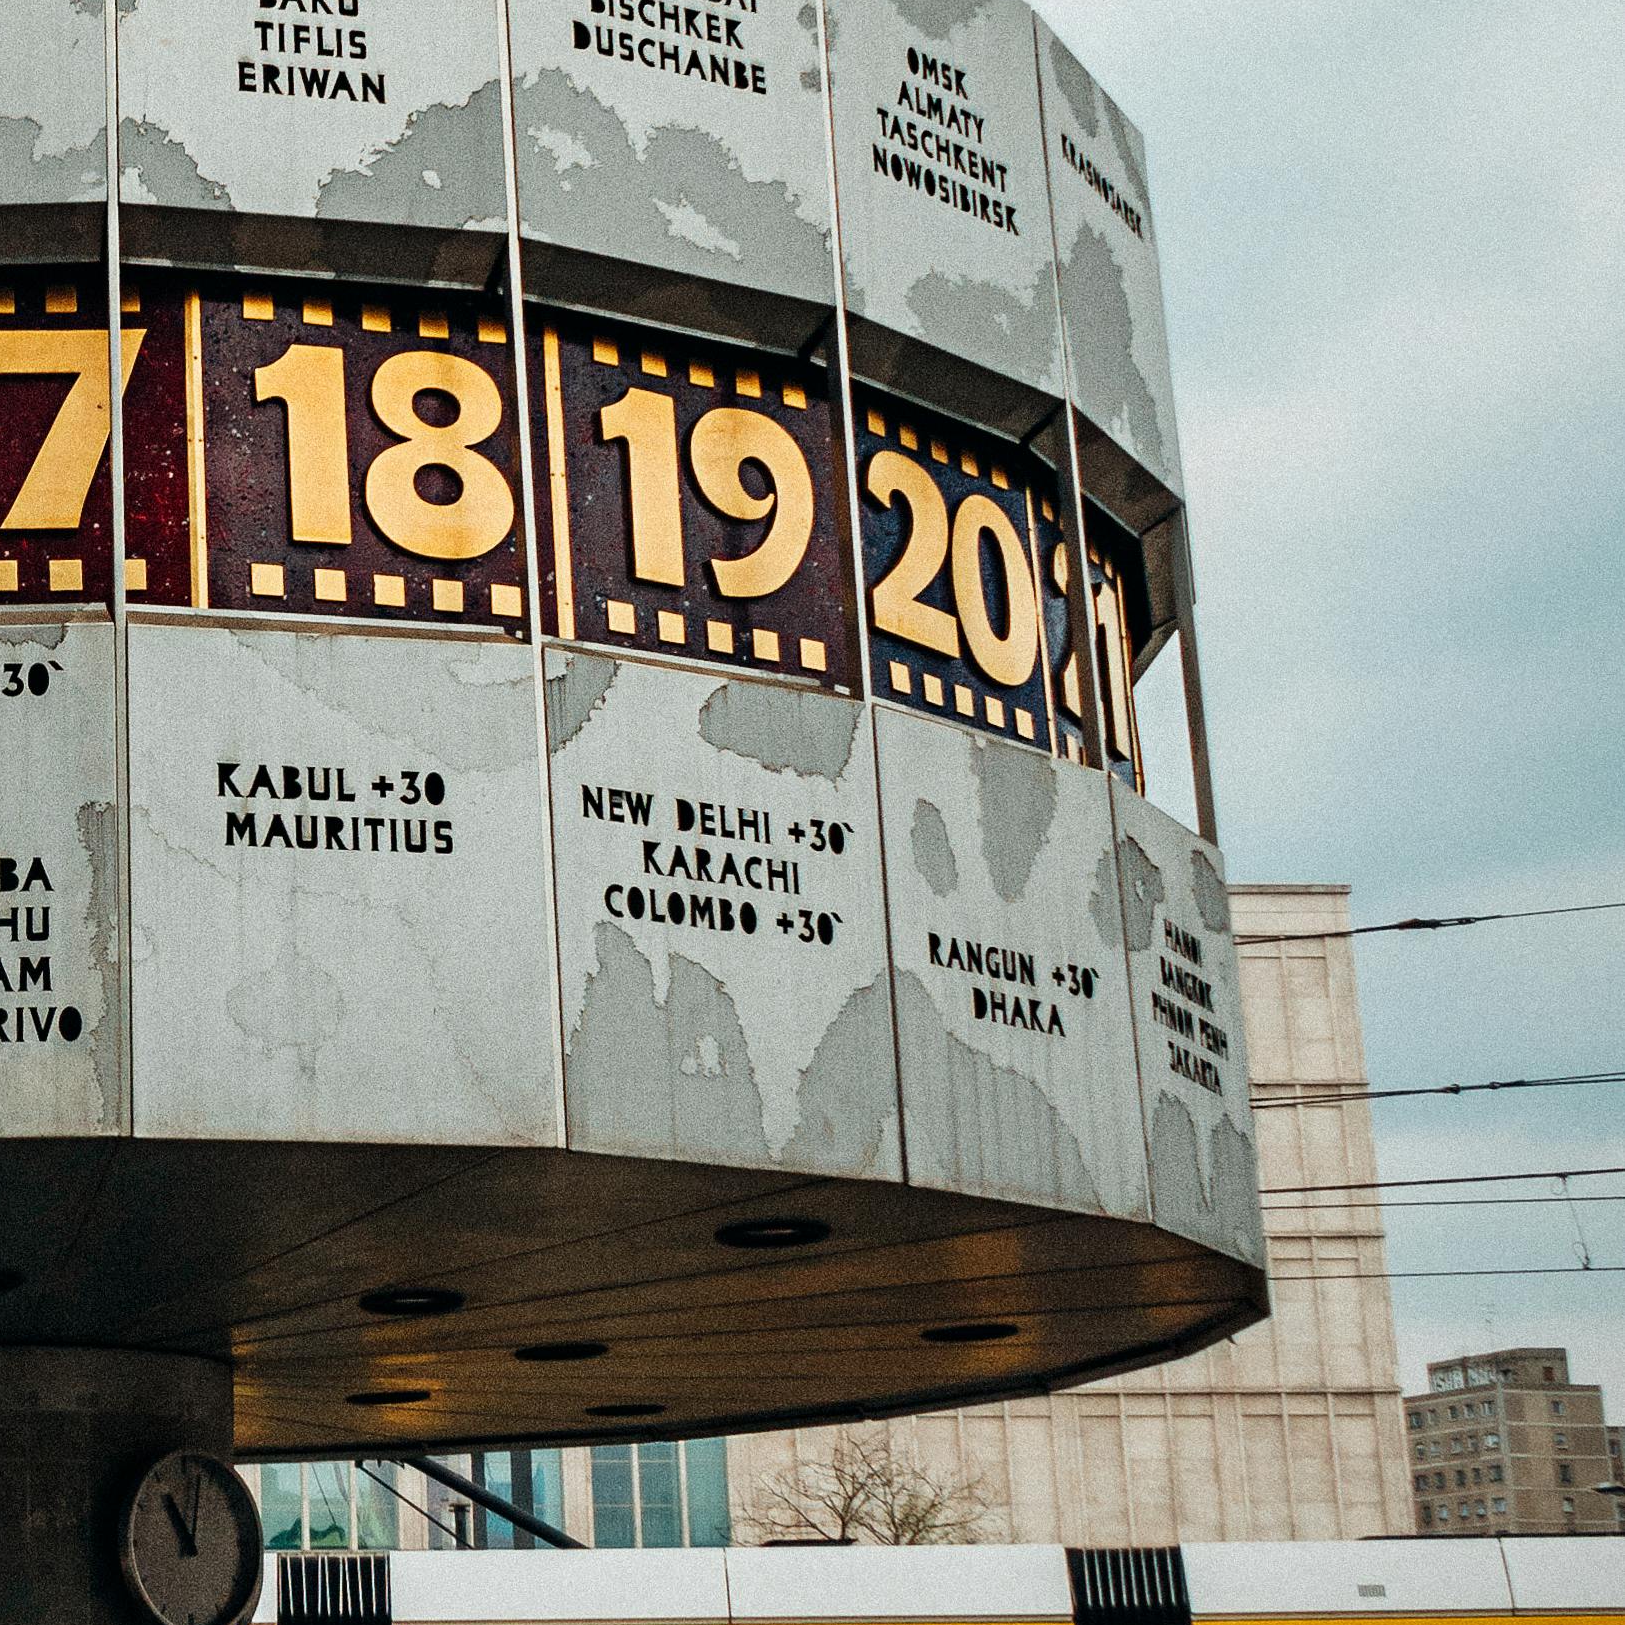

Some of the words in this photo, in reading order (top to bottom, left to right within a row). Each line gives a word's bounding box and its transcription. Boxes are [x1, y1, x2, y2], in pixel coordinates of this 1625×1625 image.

[254, 20, 367, 60] TIFLIS
[573, 20, 767, 95] DUSCHANBE
[238, 61, 385, 104] ERIWAN
[907, 47, 968, 100] OMSK
[897, 81, 984, 143] ALMATY
[876, 107, 1007, 192] TASCHKENT
[872, 144, 1019, 236] NOWOSIBIRSK
[255, 343, 514, 559] 18
[600, 387, 813, 598] 19
[868, 450, 1038, 686] 20
[217, 762, 356, 802] KABUL
[225, 811, 453, 854] MAURITIUS
[581, 784, 654, 827] NEW
[676, 798, 771, 844] DELHI
[642, 840, 800, 895] KARACHI
[604, 884, 757, 935] COLOMBO
[928, 932, 1036, 987] RANGUN
[972, 987, 1066, 1037] DHAKA
